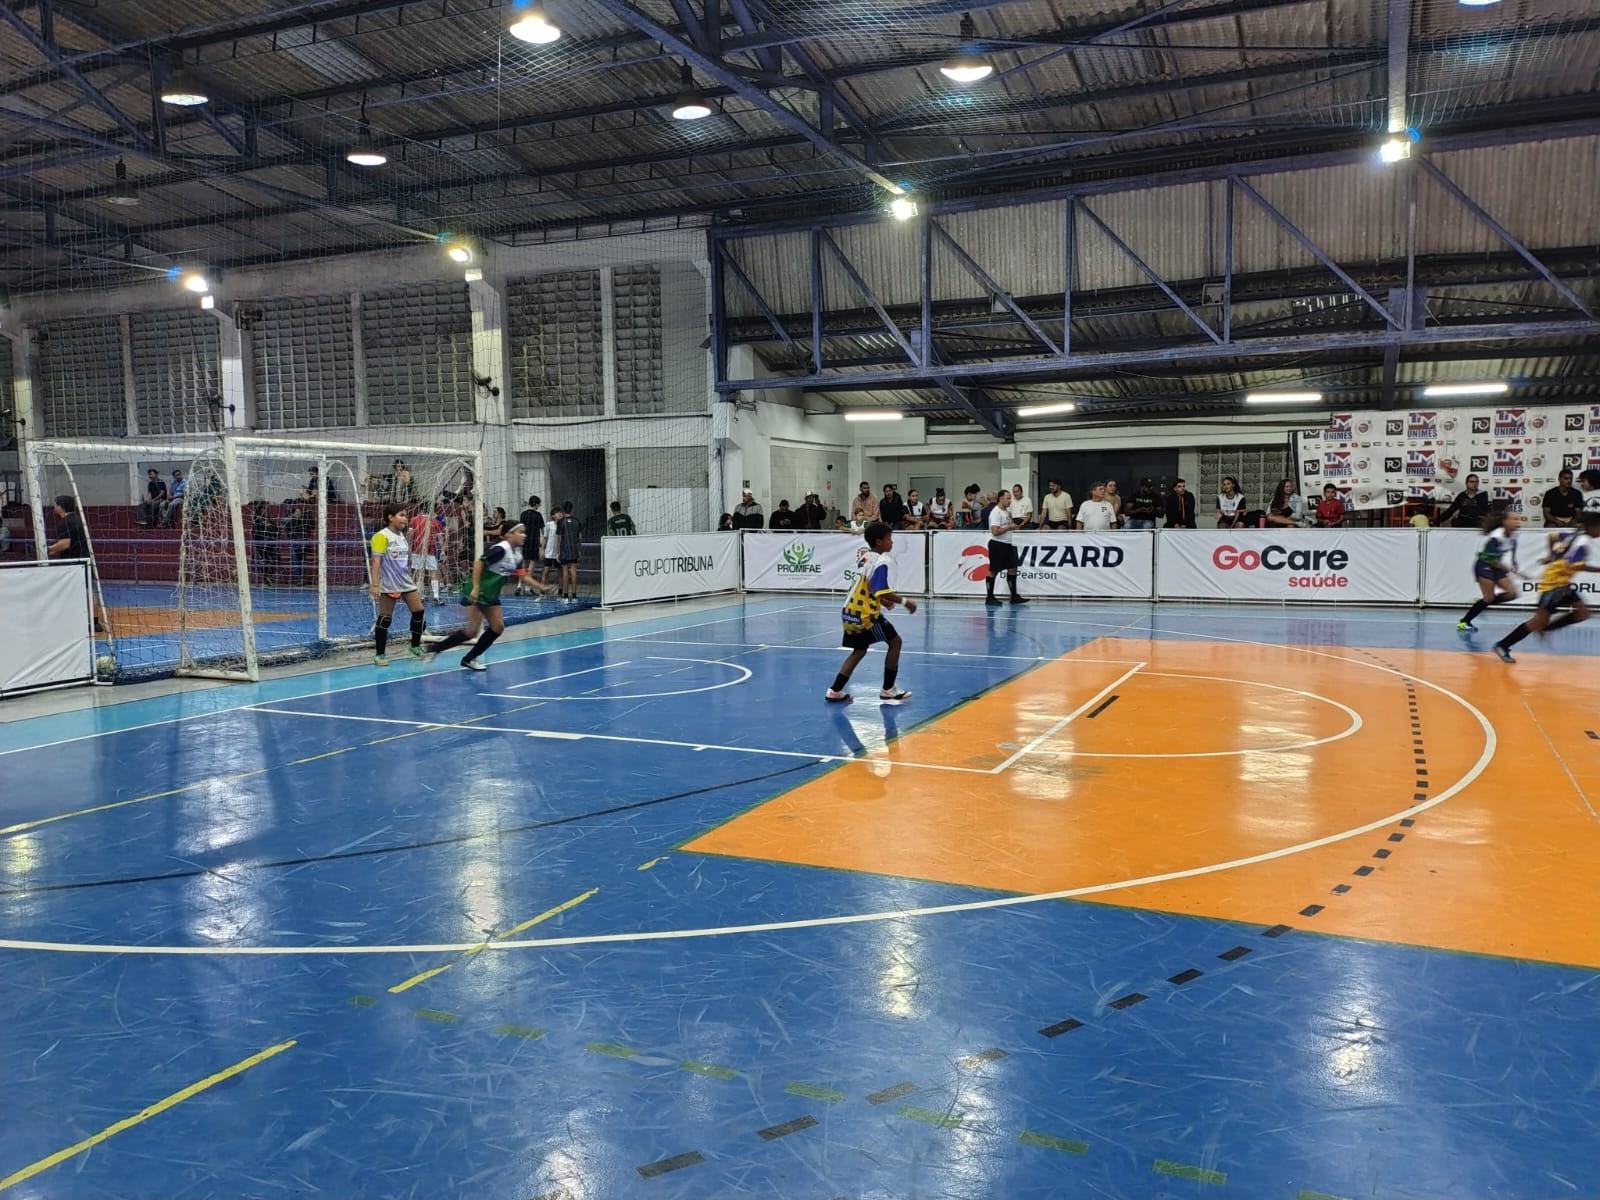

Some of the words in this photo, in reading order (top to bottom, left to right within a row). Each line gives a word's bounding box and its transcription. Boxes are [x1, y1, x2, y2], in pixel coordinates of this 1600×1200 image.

[1407, 429, 1438, 439] UNIMES
[1494, 427, 1526, 436] UNIMES
[1323, 432, 1353, 441] UNIMES
[1323, 468, 1353, 477] UNIMES
[1406, 466, 1436, 475] UNIMES
[1492, 466, 1524, 475] UNIMES
[1212, 545, 1349, 571] GoCare
[777, 564, 821, 573] PROMIFAE
[1288, 573, 1349, 588] saúde
